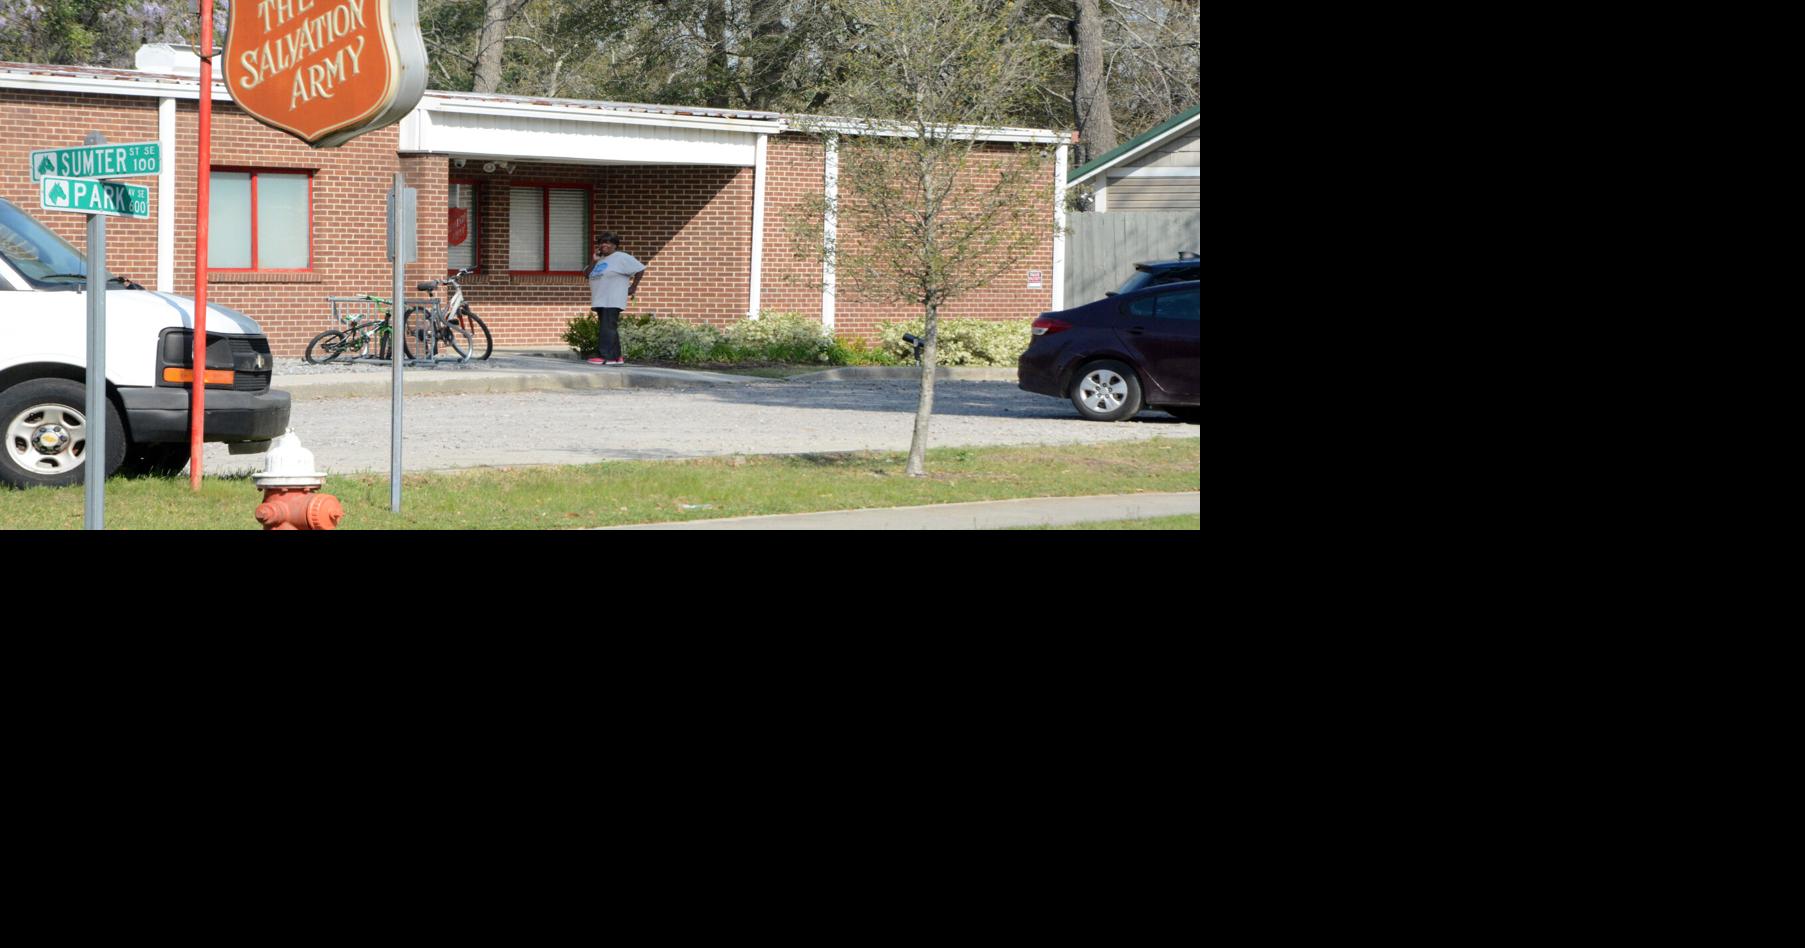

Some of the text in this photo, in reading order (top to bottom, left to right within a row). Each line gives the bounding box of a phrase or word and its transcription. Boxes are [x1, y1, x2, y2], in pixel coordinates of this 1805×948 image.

[239, 0, 367, 90] SALVATION
[289, 36, 365, 111] ARMY
[61, 146, 155, 176] SUMTER ST SE
[133, 158, 156, 171] 100
[74, 183, 125, 211] PARK
[137, 189, 145, 199] SE
[128, 200, 146, 213] 600
